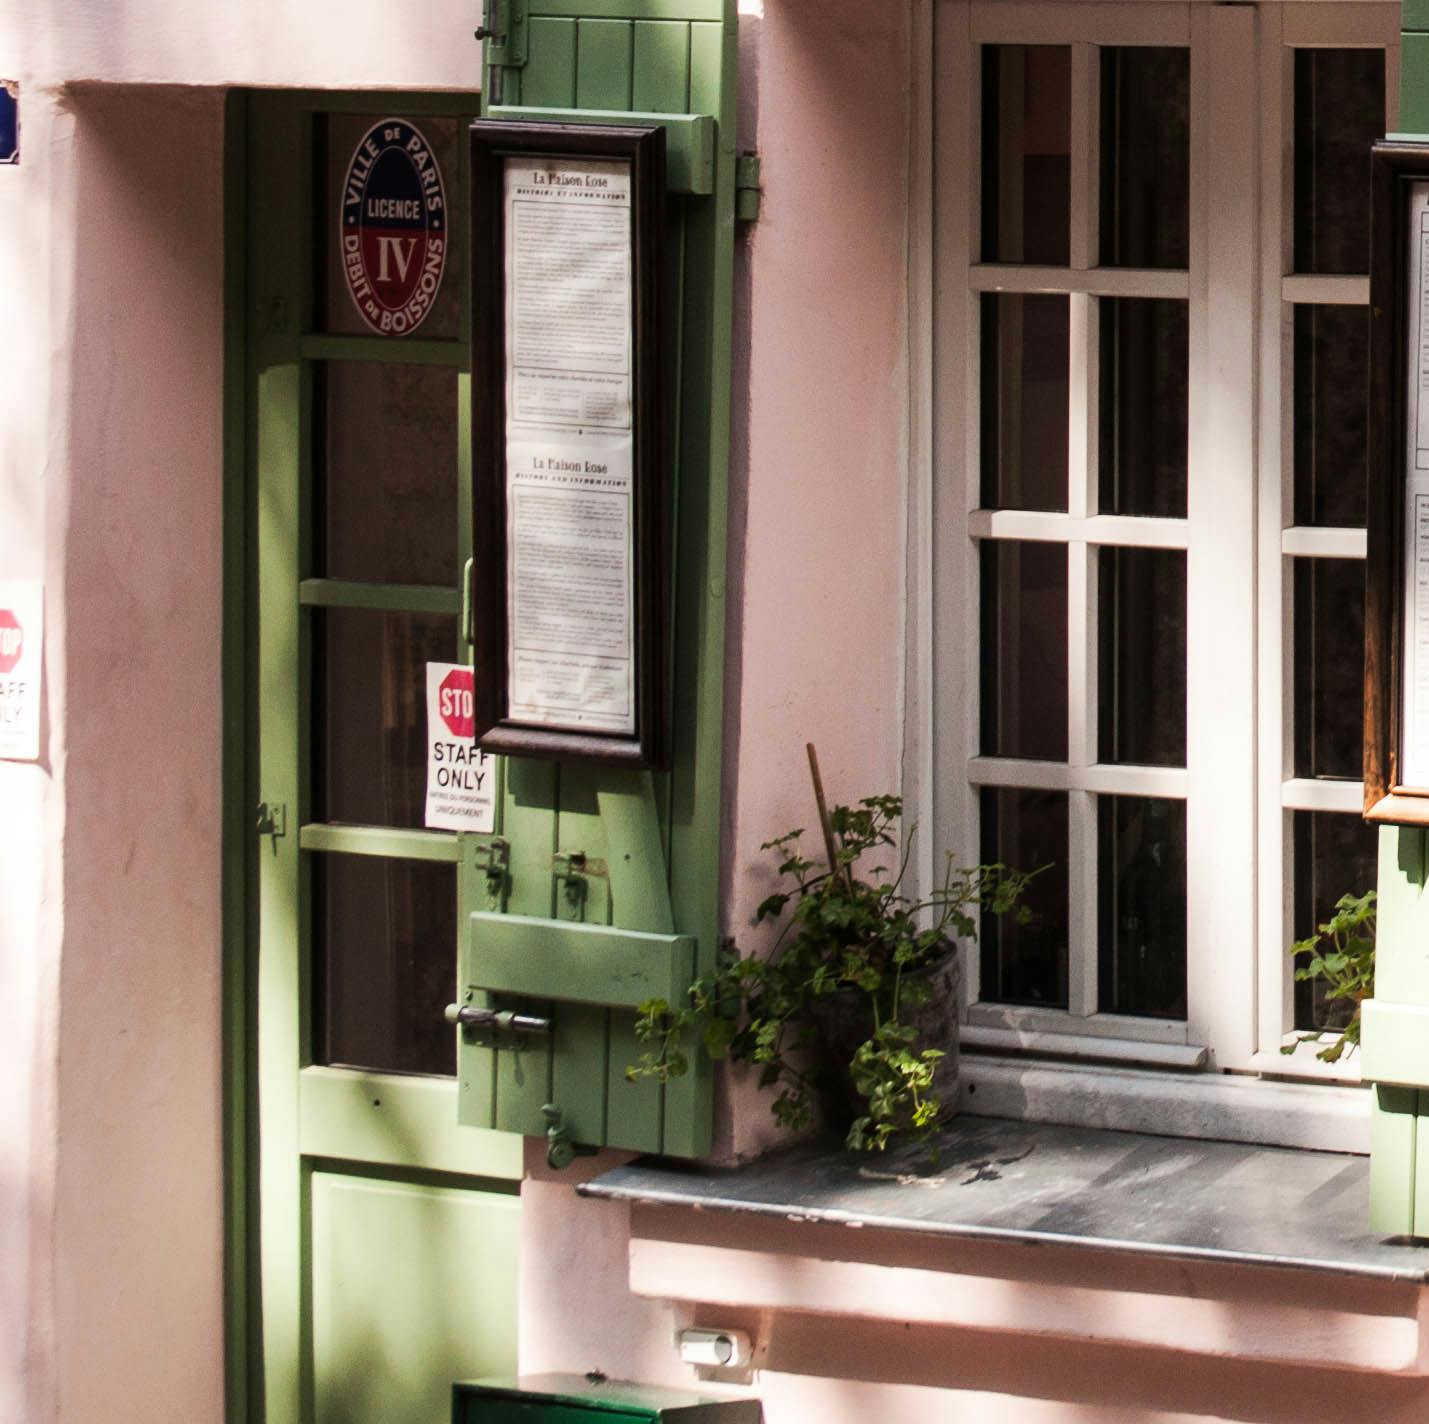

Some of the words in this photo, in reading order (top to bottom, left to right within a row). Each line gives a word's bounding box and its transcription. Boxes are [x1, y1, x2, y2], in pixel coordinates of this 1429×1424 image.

[346, 138, 380, 205] VILLE
[384, 128, 400, 141] DE
[406, 135, 442, 211] PARIS
[368, 198, 420, 219] LICENCE
[376, 237, 417, 283] IV
[345, 235, 371, 298] DEBIT
[365, 300, 380, 320] DE
[380, 239, 443, 332] BOISSONS
[441, 688, 473, 718] STO
[434, 742, 488, 766] STAFF
[437, 768, 485, 791] ONLY
